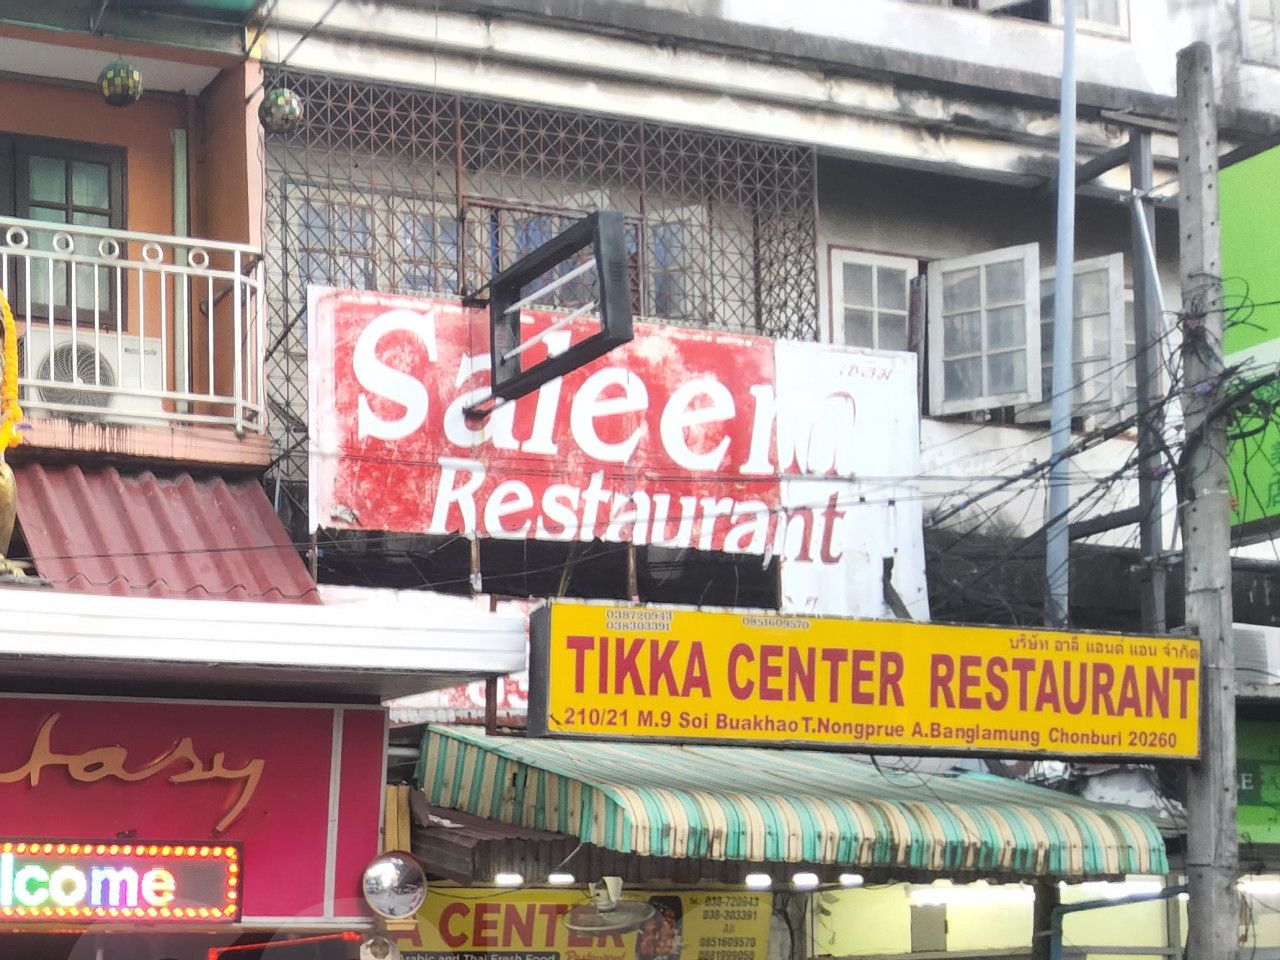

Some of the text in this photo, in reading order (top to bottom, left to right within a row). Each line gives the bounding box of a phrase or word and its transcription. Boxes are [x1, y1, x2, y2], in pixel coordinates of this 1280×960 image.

[352, 307, 857, 478] Saleem
[428, 456, 847, 568] Restaurant
[566, 635, 712, 698] TIKKA
[727, 642, 905, 708] CENTER
[930, 652, 1196, 720] RESTAURANT
[564, 707, 1178, 749] 210/21 M.9 Soi Buakhao T.Nongprue A.Banglamung Chonburi 20260
